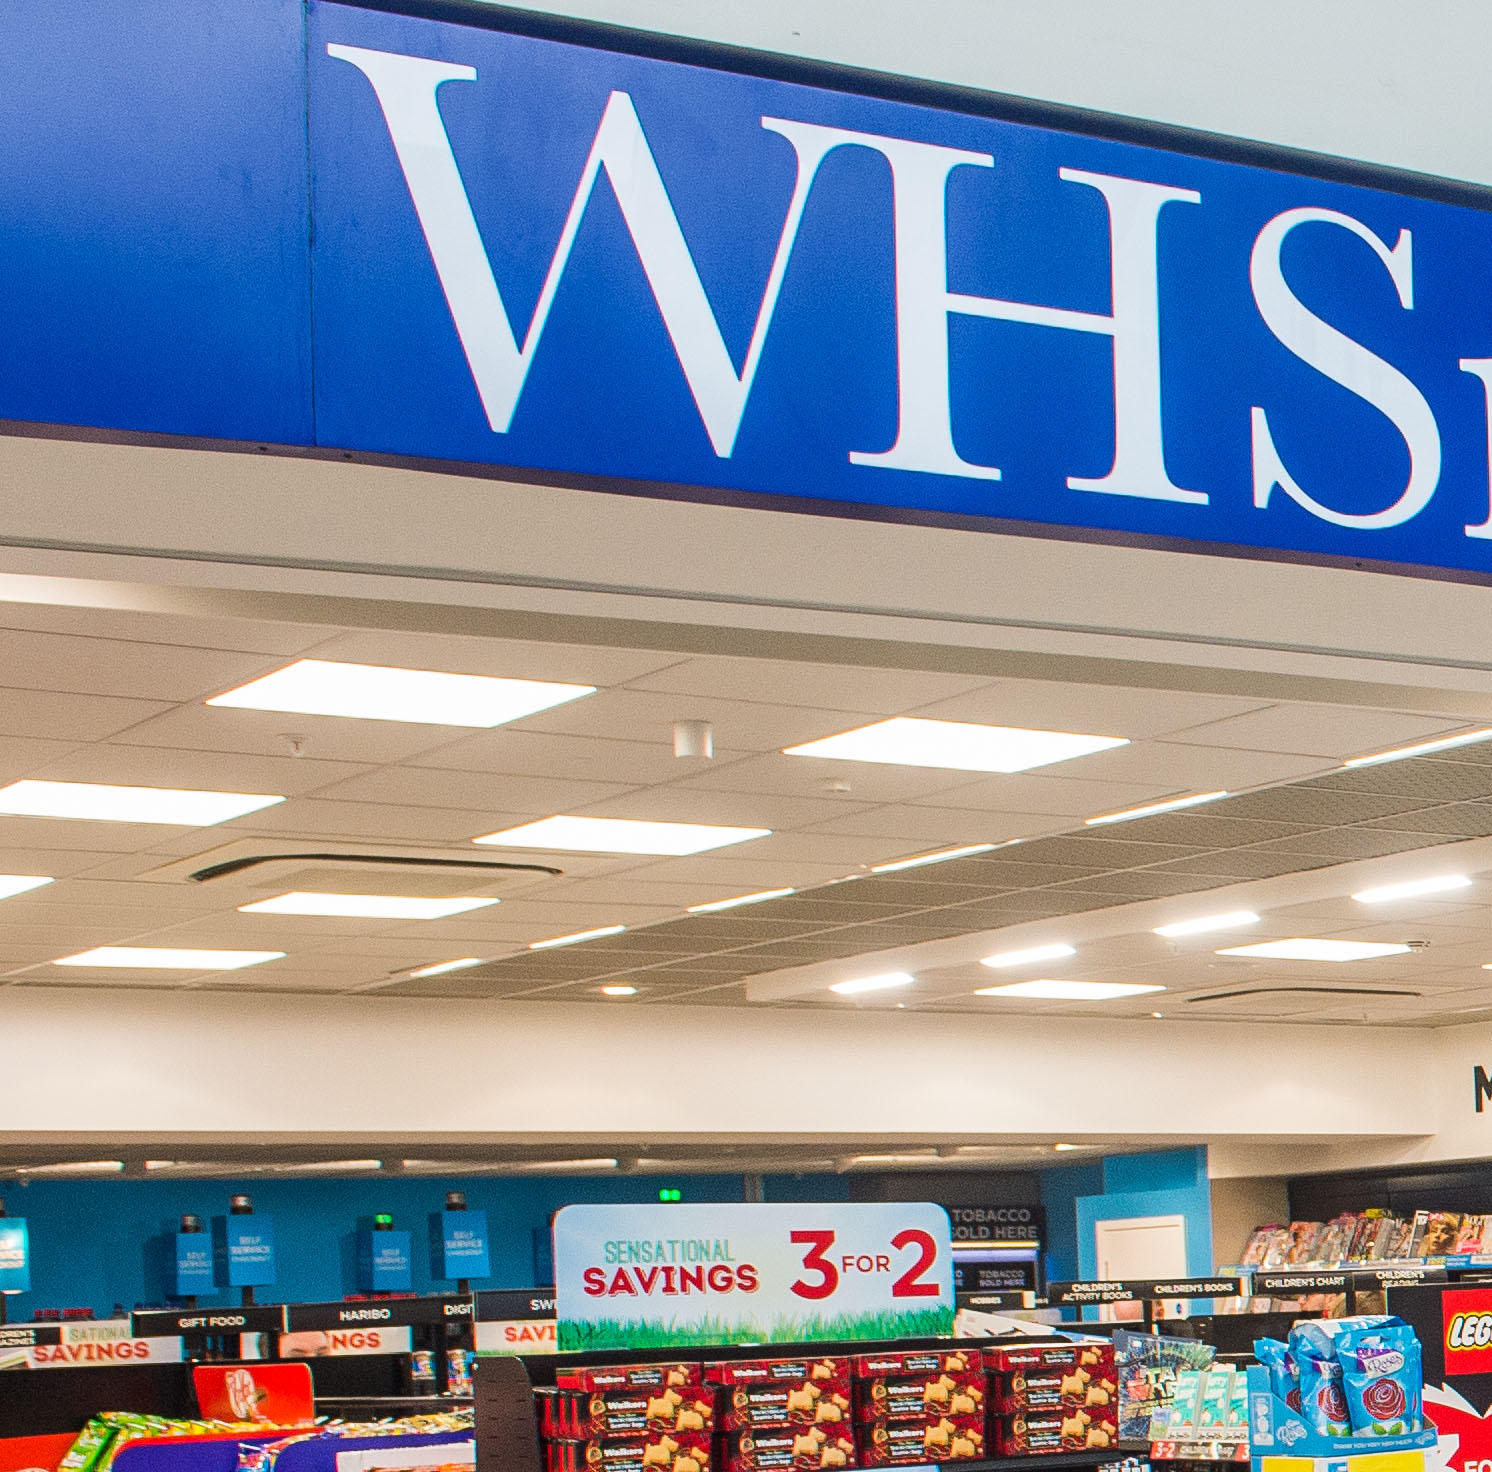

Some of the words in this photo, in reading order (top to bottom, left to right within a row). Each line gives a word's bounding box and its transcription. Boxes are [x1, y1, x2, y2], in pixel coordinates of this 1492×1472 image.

[952, 1210, 1030, 1222] TOBACCO
[996, 1226, 1037, 1238] HERE
[604, 1239, 737, 1264] SENSATIONAL
[790, 1229, 839, 1300] 3
[842, 1255, 890, 1273] FOR
[891, 1228, 941, 1298] 2
[1376, 1271, 1425, 1279] CHILDREN'S
[583, 1266, 760, 1297] SAVINGS
[1265, 1277, 1315, 1287] CHILDREN'S
[1316, 1277, 1344, 1285] CHART
[1072, 1283, 1122, 1292] CHILDREN'S
[1154, 1285, 1202, 1294] CHILDREN'S
[1204, 1283, 1234, 1292] BOOKS
[1062, 1292, 1100, 1301] ACTIVITY
[1103, 1291, 1133, 1300] BOOKS
[339, 1309, 390, 1321] HARIBO
[179, 1318, 206, 1328] GIFT
[210, 1316, 246, 1327] FOOD
[34, 1342, 150, 1362] SAVINGS
[593, 1376, 625, 1384] Walkers
[750, 1393, 788, 1402] Walkers
[888, 1388, 925, 1401] Walkers
[606, 1401, 647, 1410] Walkers
[756, 1438, 793, 1447] Walkers
